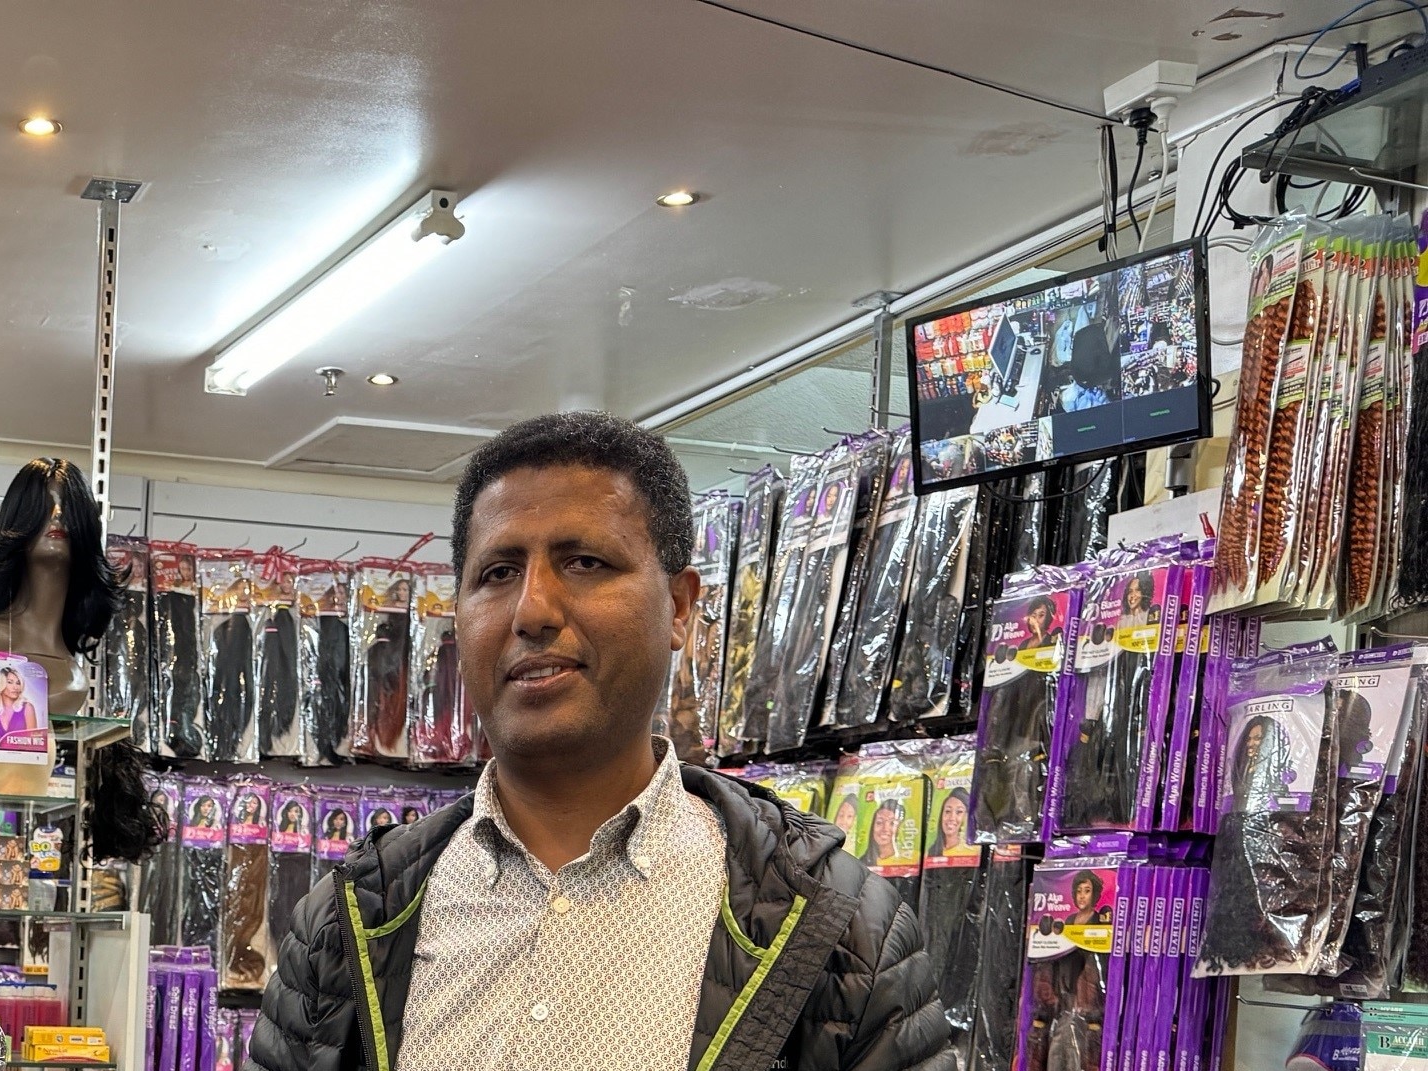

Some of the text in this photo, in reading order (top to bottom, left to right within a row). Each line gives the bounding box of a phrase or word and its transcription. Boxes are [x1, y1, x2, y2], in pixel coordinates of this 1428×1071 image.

[1003, 630, 1025, 641] Weave
[1162, 598, 1175, 654] DARLING
[1188, 597, 1201, 654] DARLING
[1047, 901, 1070, 912] Weave
